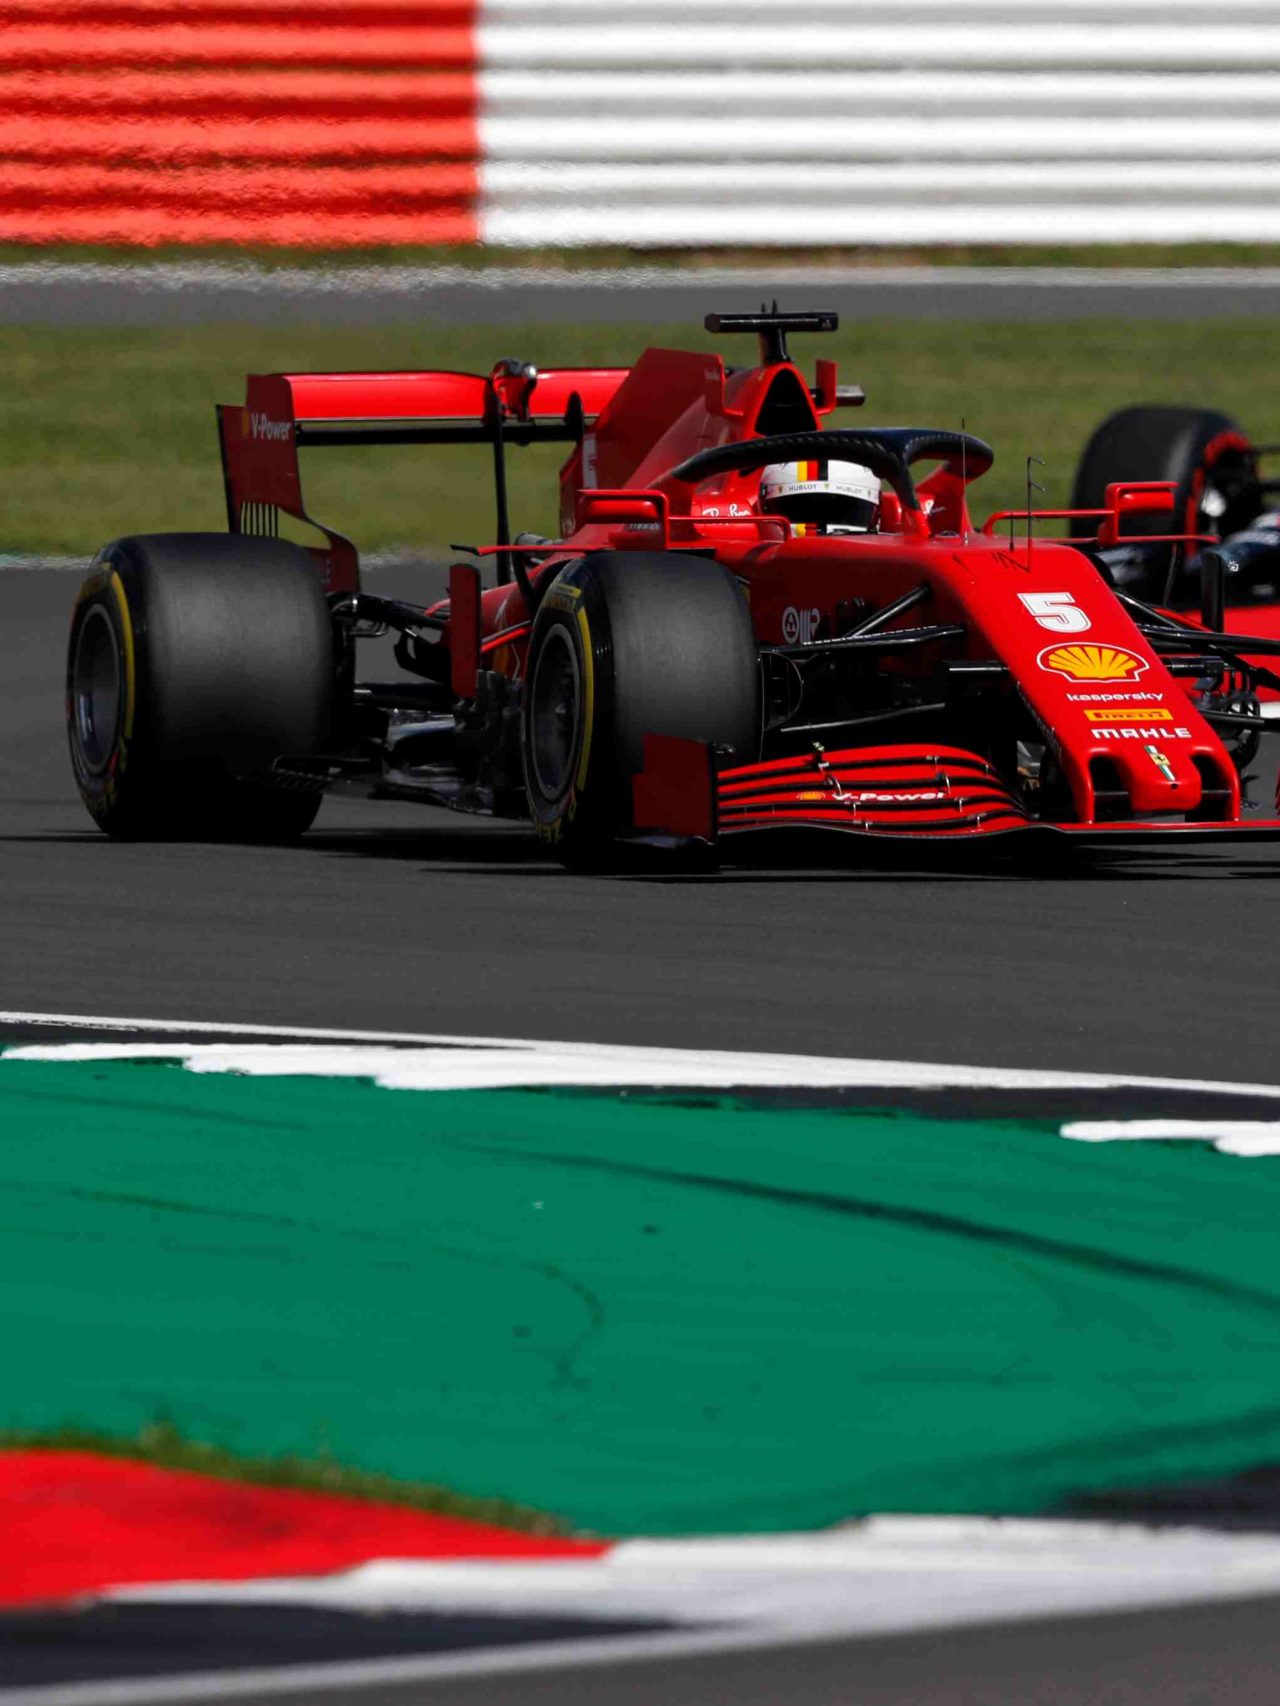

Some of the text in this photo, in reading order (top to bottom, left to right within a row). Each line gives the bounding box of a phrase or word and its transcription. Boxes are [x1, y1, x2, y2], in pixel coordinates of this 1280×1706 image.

[251, 413, 291, 440] V-Power
[789, 483, 817, 492] HUBLOT
[835, 485, 862, 496] HUBLOT
[1017, 592, 1092, 634] 5
[1066, 692, 1163, 702] kaspersky
[1091, 728, 1192, 739] MAHLE
[832, 792, 944, 801] V-Power
